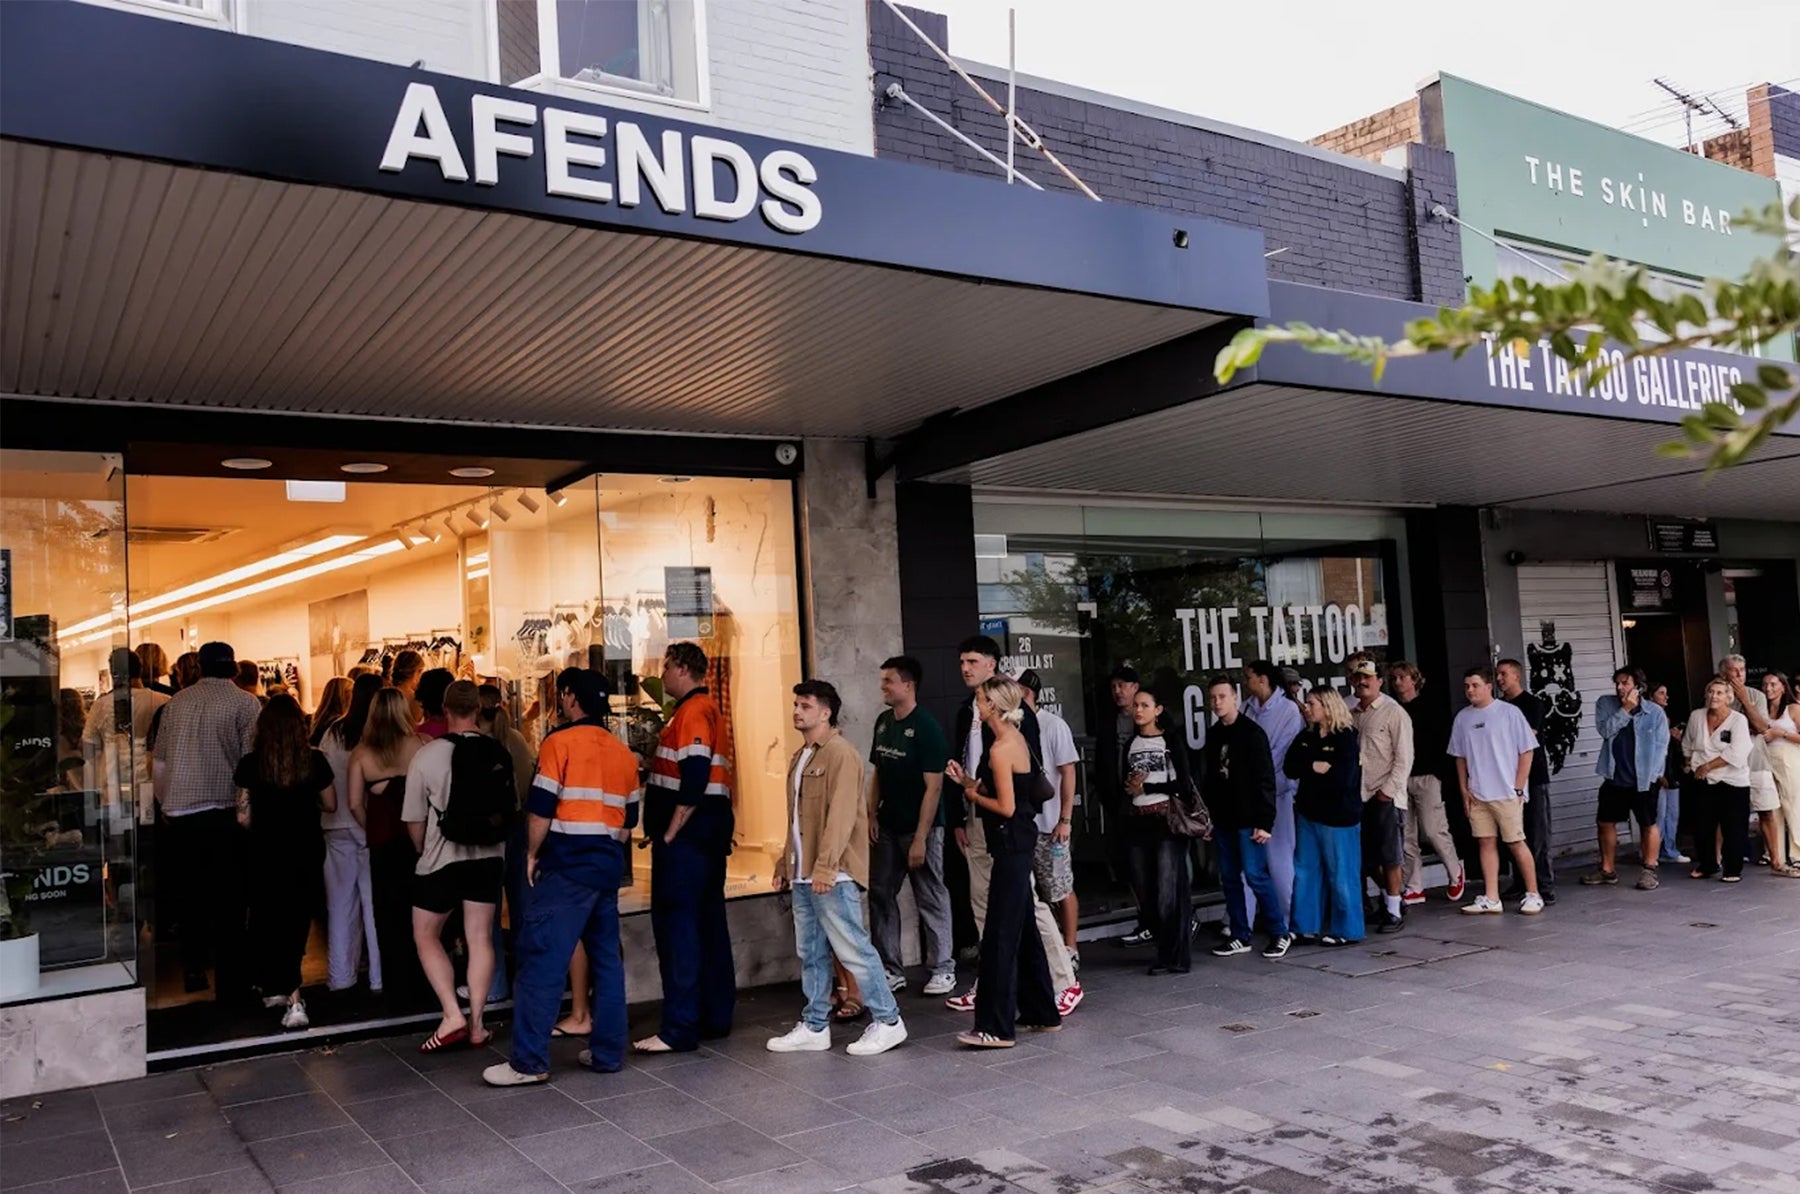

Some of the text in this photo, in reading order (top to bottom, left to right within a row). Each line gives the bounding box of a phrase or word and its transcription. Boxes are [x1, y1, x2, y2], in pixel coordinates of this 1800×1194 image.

[379, 82, 822, 233] AFENDS
[1525, 156, 1584, 197] THE
[1682, 199, 1732, 235] BAR
[1480, 331, 1534, 391] THE
[1018, 636, 1031, 653] 26
[1175, 603, 1364, 671] THE TATTOO
[1043, 654, 1054, 669] ST
[1036, 687, 1056, 703] AYS
[40, 890, 67, 901] SOON
